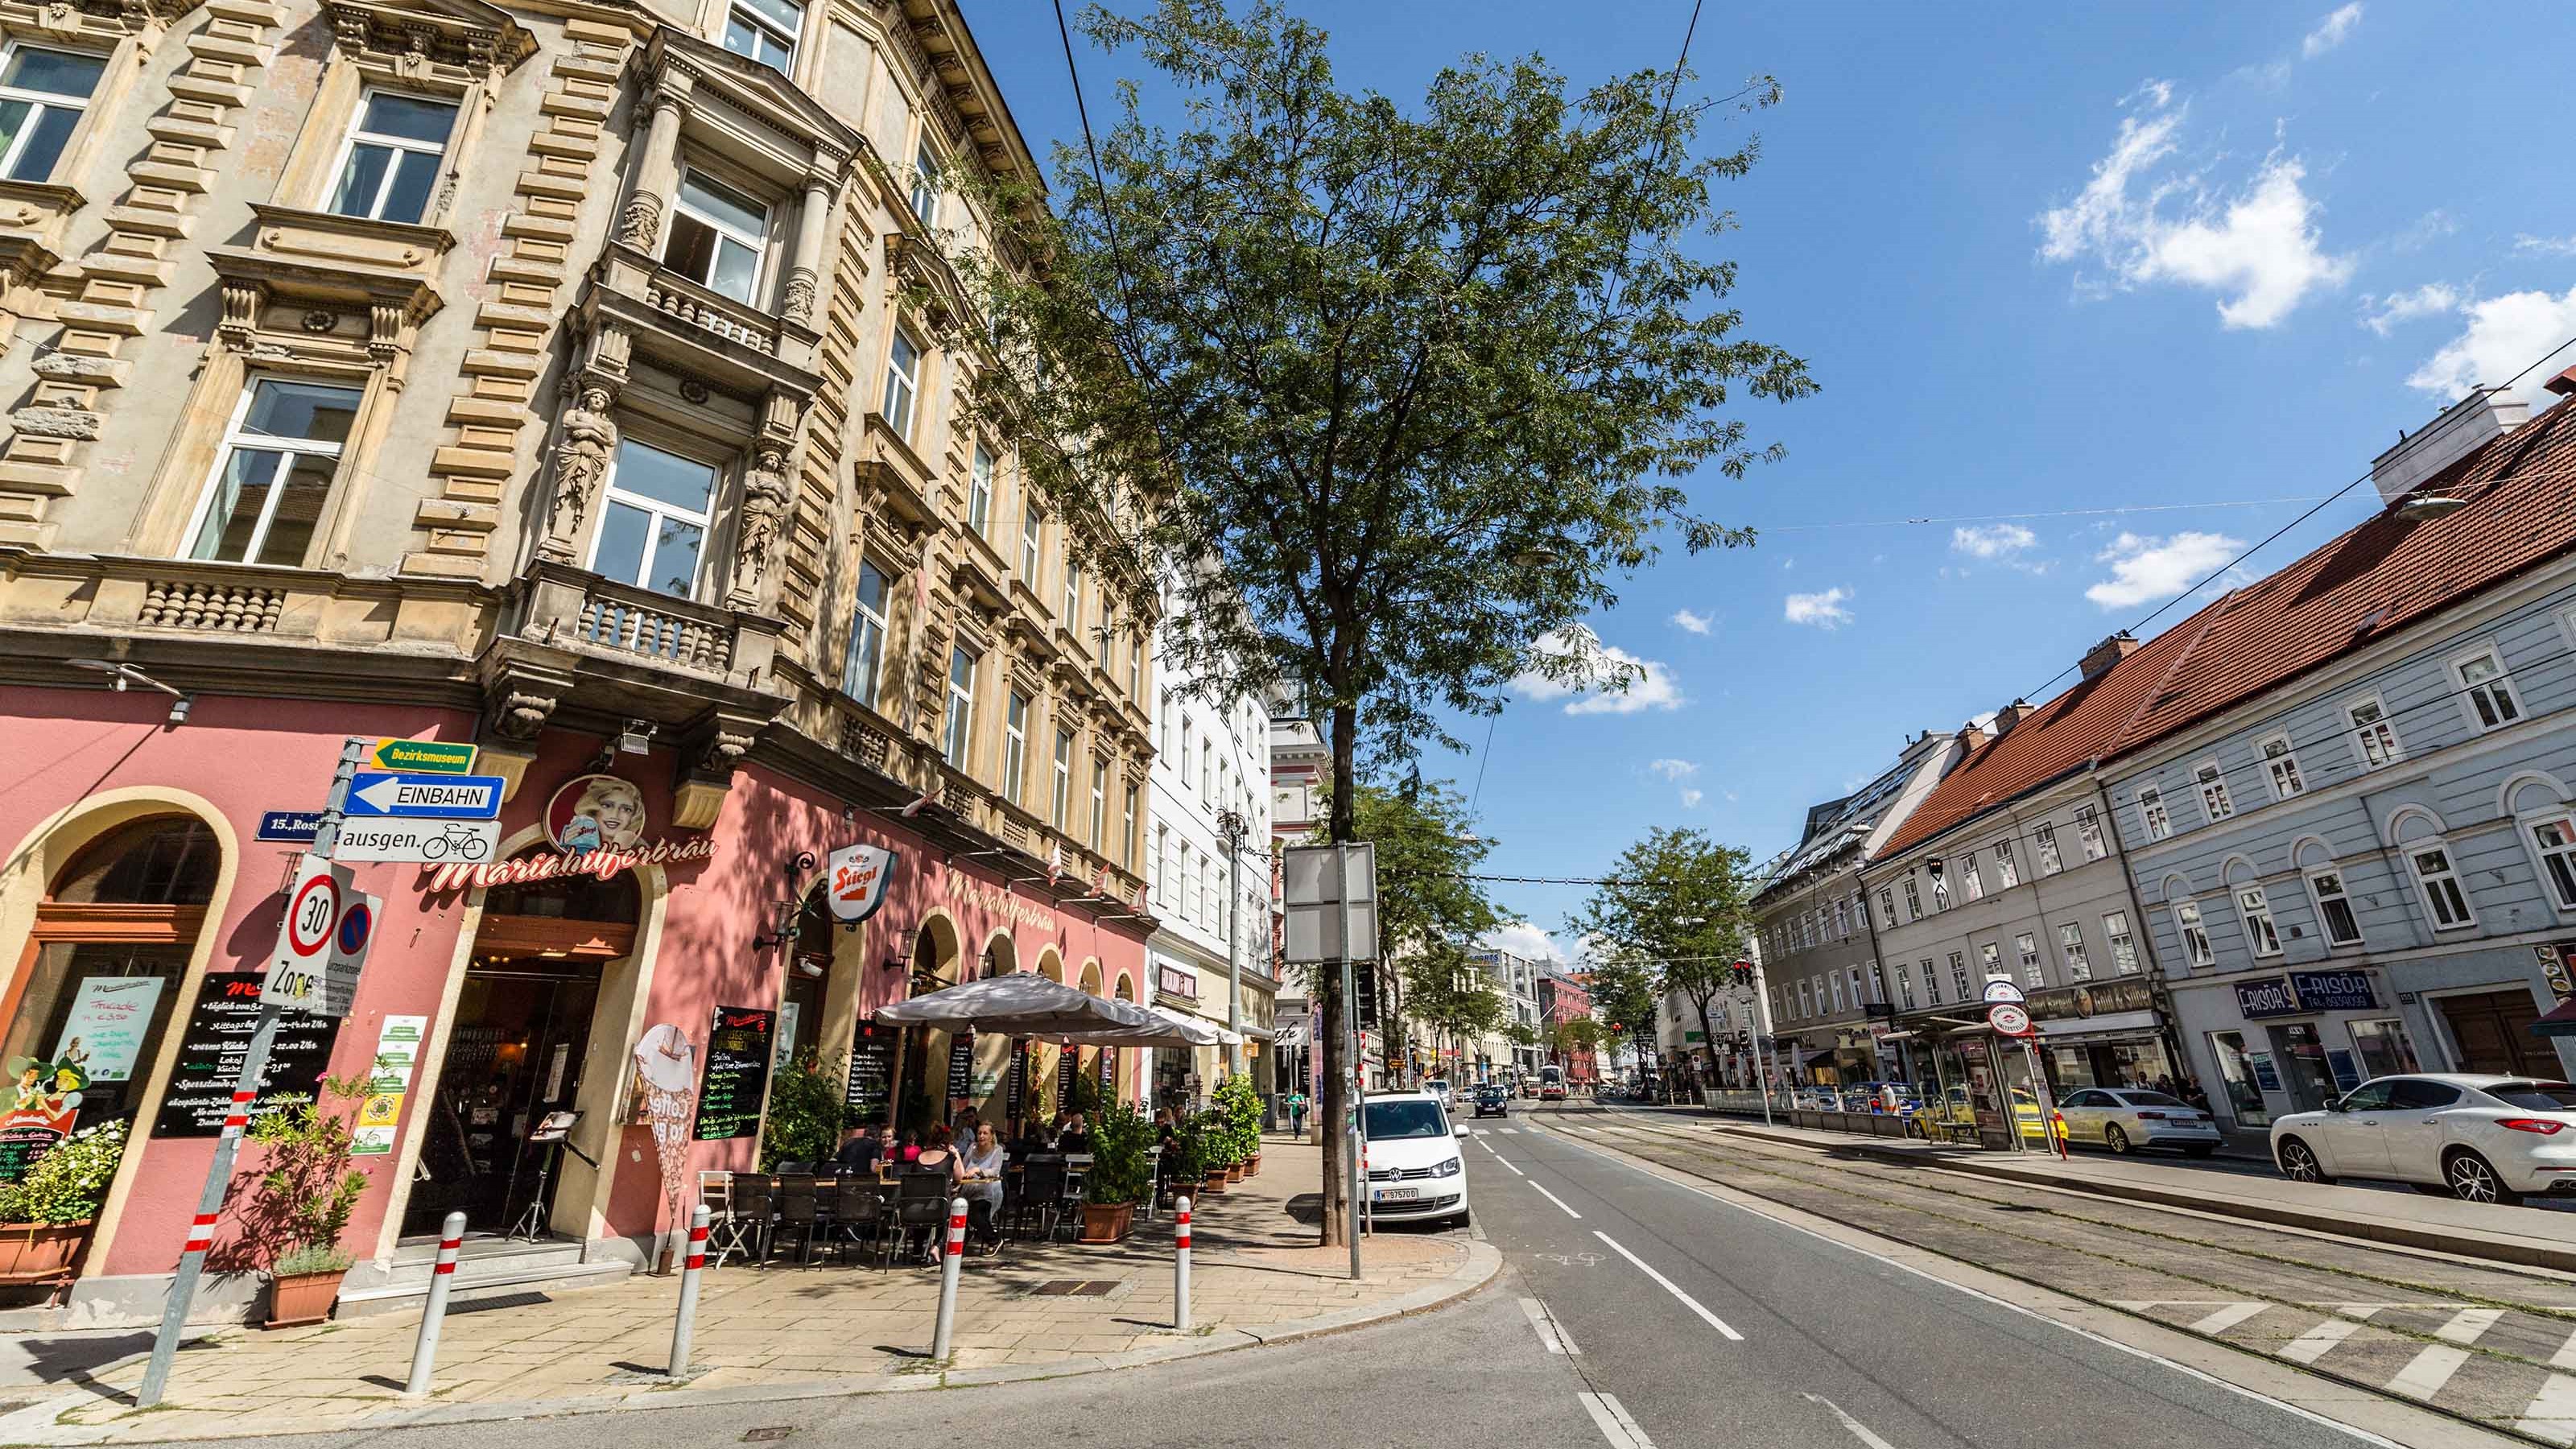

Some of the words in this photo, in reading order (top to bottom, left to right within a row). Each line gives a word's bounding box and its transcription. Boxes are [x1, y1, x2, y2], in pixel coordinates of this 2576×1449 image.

[391, 748, 467, 766] Bezirksmuseum
[398, 786, 484, 805] EINBAHN
[343, 832, 421, 851] ausgen.
[423, 837, 720, 893] Mariahilferbräu
[833, 865, 877, 894] Stiegl
[301, 895, 329, 935] 30
[2296, 972, 2370, 997] FRISÖR
[2237, 984, 2283, 1015] FRISÖR
[216, 1063, 242, 1073] Küche
[218, 1055, 243, 1064] Lokal
